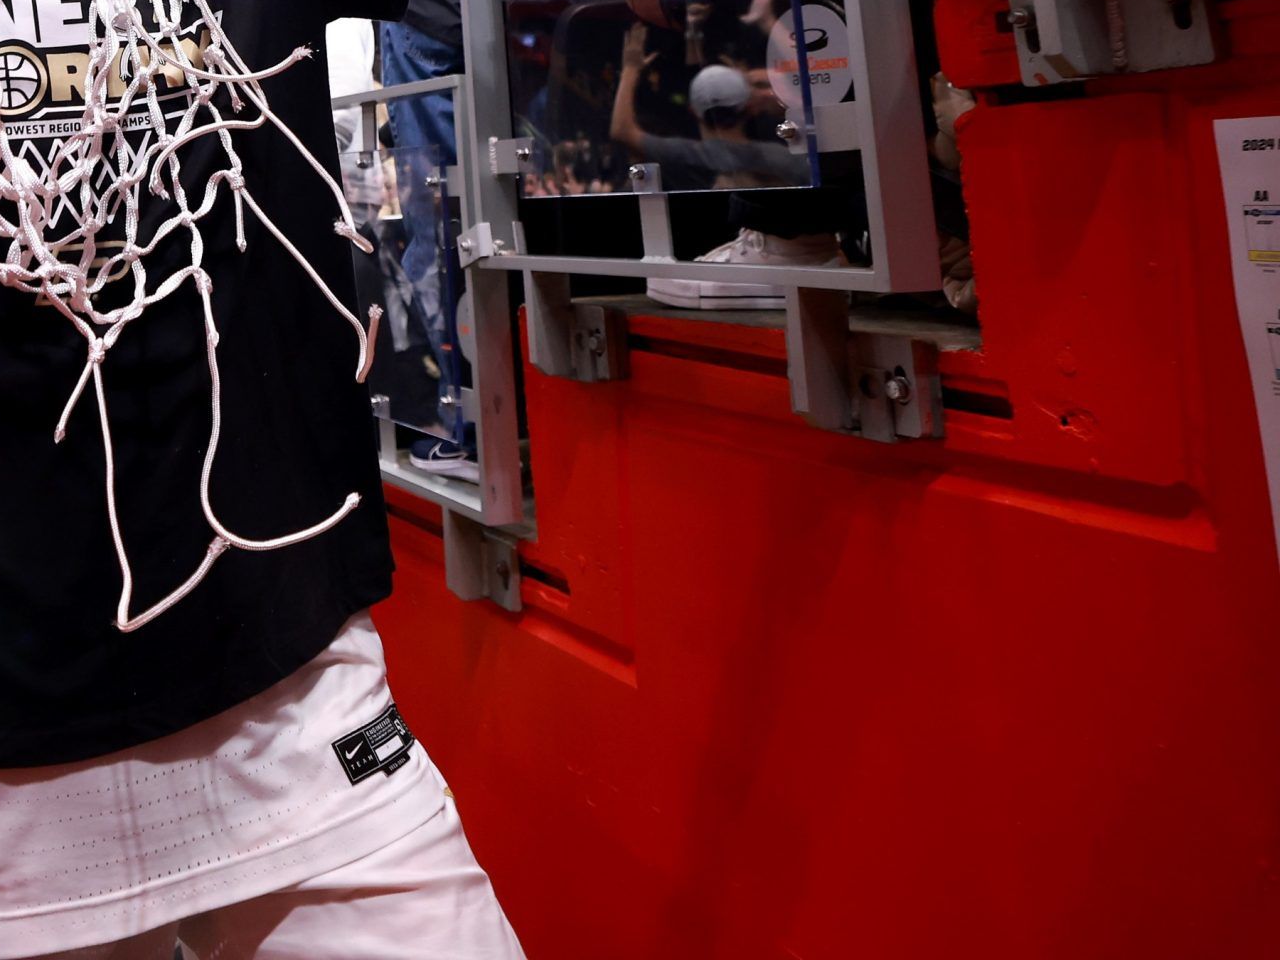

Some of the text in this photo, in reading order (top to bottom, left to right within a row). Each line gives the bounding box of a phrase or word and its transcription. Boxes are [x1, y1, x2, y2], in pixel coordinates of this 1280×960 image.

[792, 72, 831, 86] aena
[5, 124, 46, 136] DWEST
[350, 754, 374, 771] TEAM
